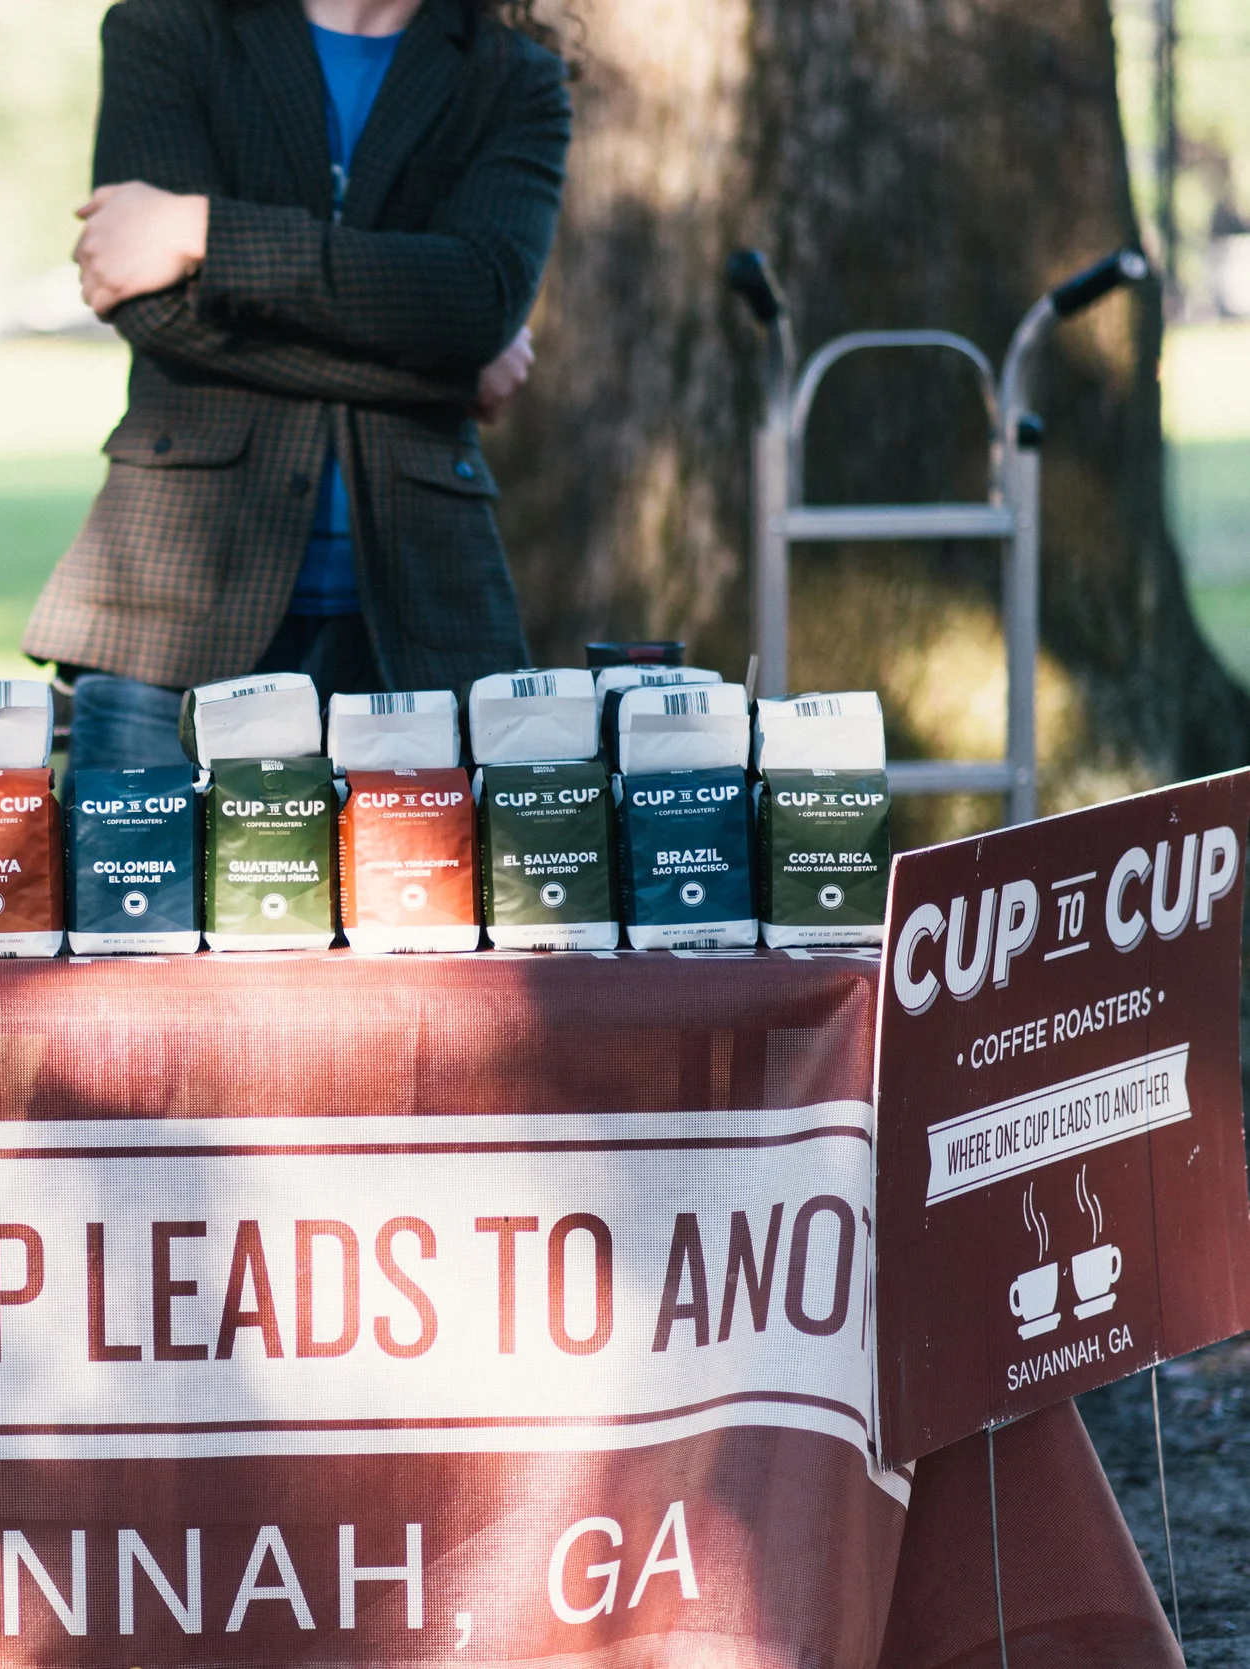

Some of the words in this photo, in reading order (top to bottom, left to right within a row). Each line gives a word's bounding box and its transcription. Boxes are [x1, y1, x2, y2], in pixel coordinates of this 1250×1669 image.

[357, 792, 400, 808] CUP
[420, 792, 463, 807] CUP
[495, 792, 538, 807] CUP
[558, 788, 600, 804] CUP
[632, 790, 675, 806] CUP
[696, 786, 739, 802] CUP
[777, 792, 820, 806] CUP
[841, 793, 884, 806] CUP
[0, 797, 43, 813] CUP
[81, 800, 124, 814] CUP
[145, 797, 187, 813] CUP
[221, 800, 264, 817] CUP
[285, 800, 326, 817] CUP
[504, 855, 520, 866] EL
[524, 852, 598, 866] SALVADOR
[656, 848, 722, 865] BRAZIL
[789, 853, 836, 864] COSTA
[839, 853, 872, 864] RICA
[93, 861, 176, 874] COLOMBIA
[229, 860, 318, 873] GUATEMALA
[525, 867, 544, 875] SAN
[547, 866, 578, 874] PEDRO
[652, 867, 672, 875] SAO
[674, 863, 729, 874] FRANCISCO
[122, 875, 162, 883] OBRAJE
[893, 878, 1040, 1016] CUP
[1057, 890, 1086, 941] TO
[1105, 825, 1240, 953] CUP
[970, 1018, 1048, 1069] COFFEE
[1053, 986, 1152, 1044] ROASTERS
[947, 1126, 992, 1176] WHERE
[995, 1119, 1021, 1158] ONE
[1023, 1110, 1050, 1148] CUP
[1052, 1096, 1091, 1140] LEADS
[1094, 1090, 1111, 1127] TO
[1113, 1071, 1171, 1122] ANOTHER
[86, 1214, 438, 1363] LEADS
[473, 1211, 614, 1356] TO
[651, 1195, 872, 1353] ANO
[1007, 1334, 1105, 1391] SAVANNAH,
[1108, 1324, 1133, 1355] GA
[547, 1499, 701, 1625] GA
